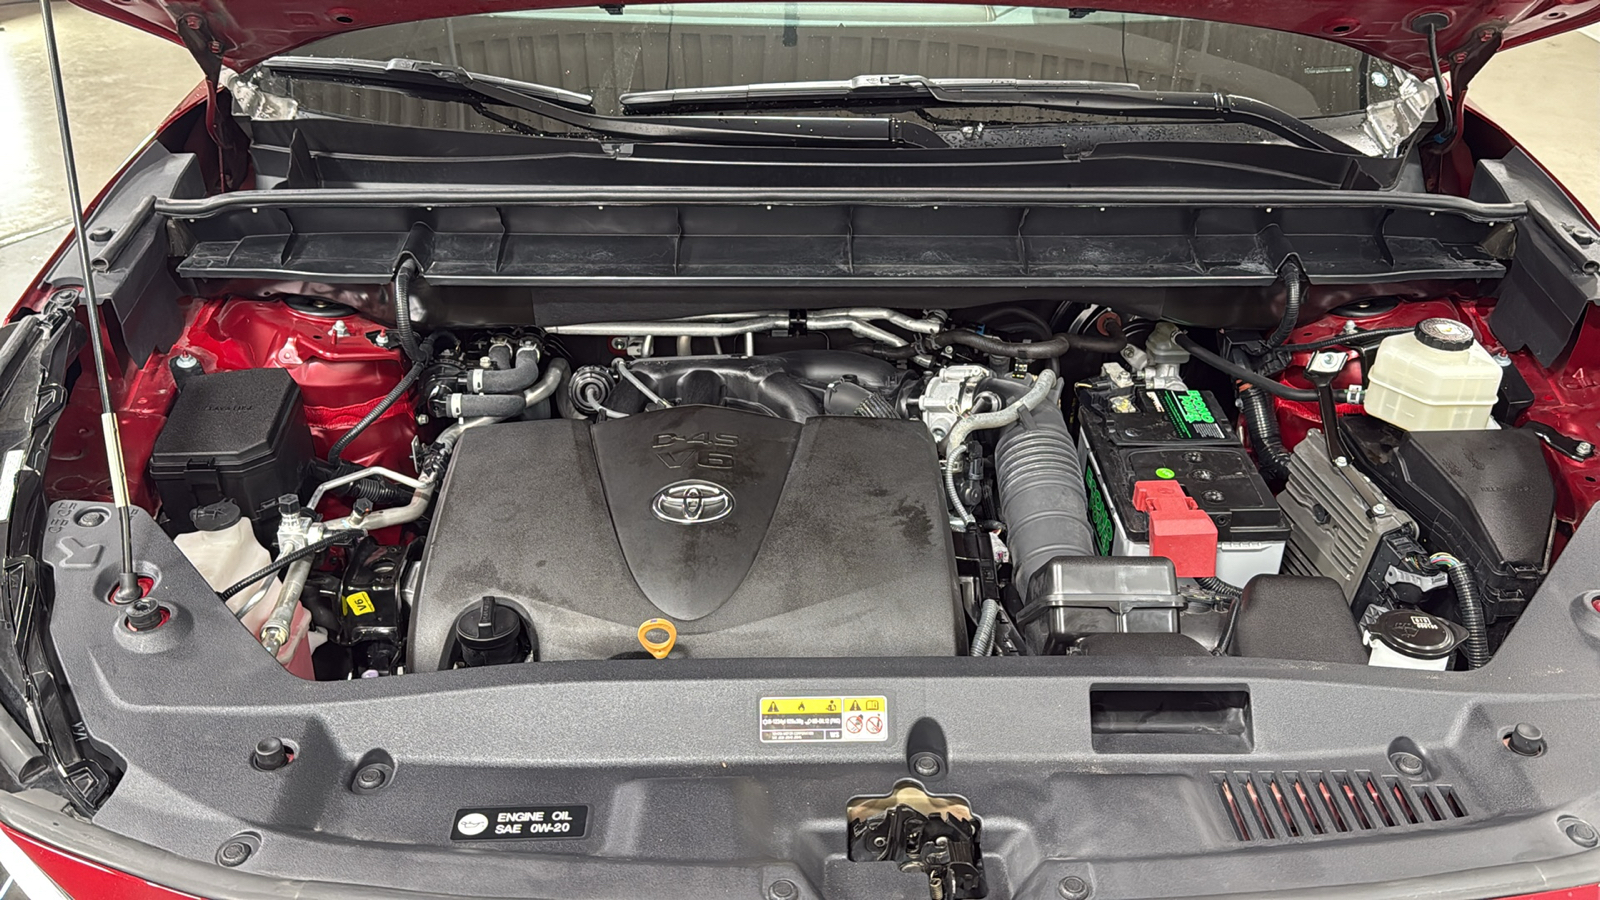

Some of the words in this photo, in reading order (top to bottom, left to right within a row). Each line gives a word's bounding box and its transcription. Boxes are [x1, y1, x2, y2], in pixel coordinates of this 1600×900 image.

[1187, 390, 1215, 423] ECONO
[656, 451, 734, 469] V6
[497, 811, 545, 822] ENGINE
[551, 811, 573, 821] OIL
[494, 823, 522, 834] SAE
[530, 822, 570, 833] 0W-20
